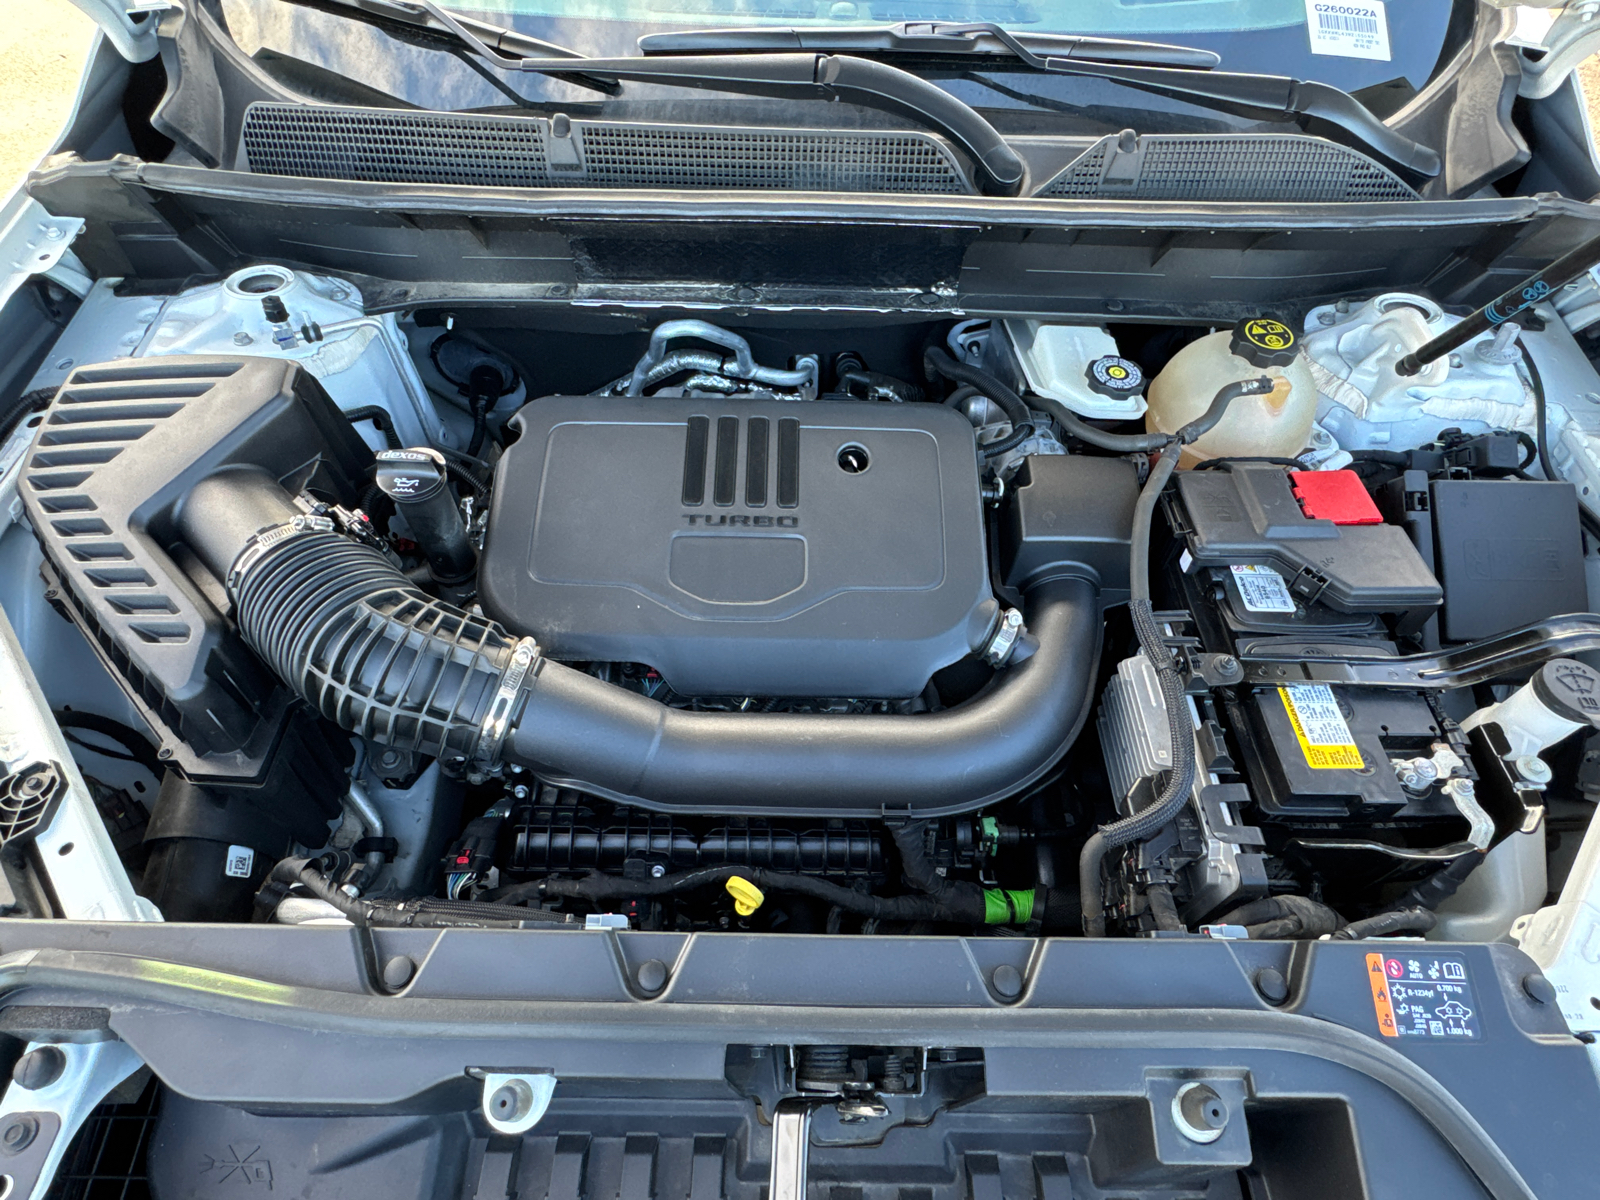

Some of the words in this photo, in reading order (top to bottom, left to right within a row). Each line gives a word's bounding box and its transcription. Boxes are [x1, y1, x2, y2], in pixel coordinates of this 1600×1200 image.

[1314, 4, 1377, 18] G260022A
[381, 450, 426, 460] dexos
[681, 514, 799, 528] TURBO
[1407, 988, 1434, 998] R-1234yf
[1436, 984, 1453, 992] 0.700
[1453, 985, 1462, 994] kg
[1411, 1005, 1424, 1013] PAG
[1446, 1027, 1463, 1035] 1.000
[1463, 1027, 1473, 1037] kg
